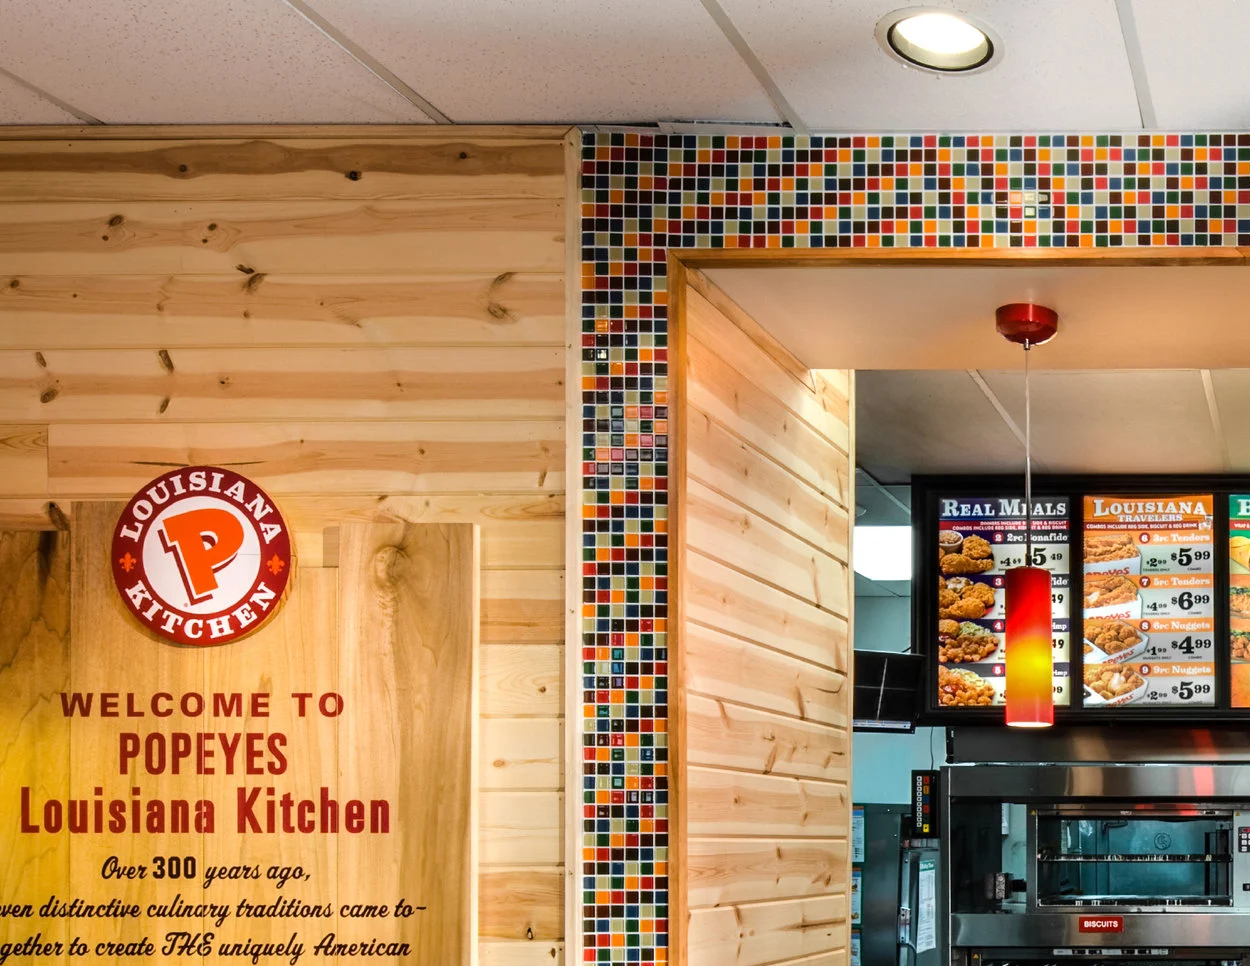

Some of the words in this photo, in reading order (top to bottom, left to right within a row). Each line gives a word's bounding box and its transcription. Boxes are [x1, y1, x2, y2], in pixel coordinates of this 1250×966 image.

[120, 471, 282, 544] LOUISIANA
[942, 499, 995, 516] REAL
[1094, 500, 1206, 516] LOUISIANA
[1118, 514, 1182, 522] TRAVELERS
[1171, 534, 1210, 542] Tenders
[125, 580, 276, 639] KITCHEN
[1171, 621, 1210, 630] Nuggets
[1172, 665, 1211, 675] Nuggets
[60, 692, 271, 718] WELCOME
[291, 692, 345, 718] TO
[119, 732, 288, 776] POPEYES
[20, 786, 215, 834] Louisiana
[236, 786, 391, 834] Kitchen
[102, 856, 147, 879] Over
[153, 857, 195, 879] 300
[203, 865, 261, 889] years
[267, 867, 310, 889] ago,
[0, 904, 34, 917] ven
[39, 896, 141, 917] distinctive
[147, 894, 229, 927] culinary
[236, 896, 333, 917] traditions
[340, 905, 388, 917] came
[394, 899, 426, 917] to-
[1084, 920, 1118, 928] BISCUITS
[0, 933, 63, 965] gether
[68, 937, 89, 956] to
[96, 937, 155, 956] create
[162, 932, 214, 956] THE
[219, 933, 304, 965] uniquely
[314, 933, 411, 956] American
